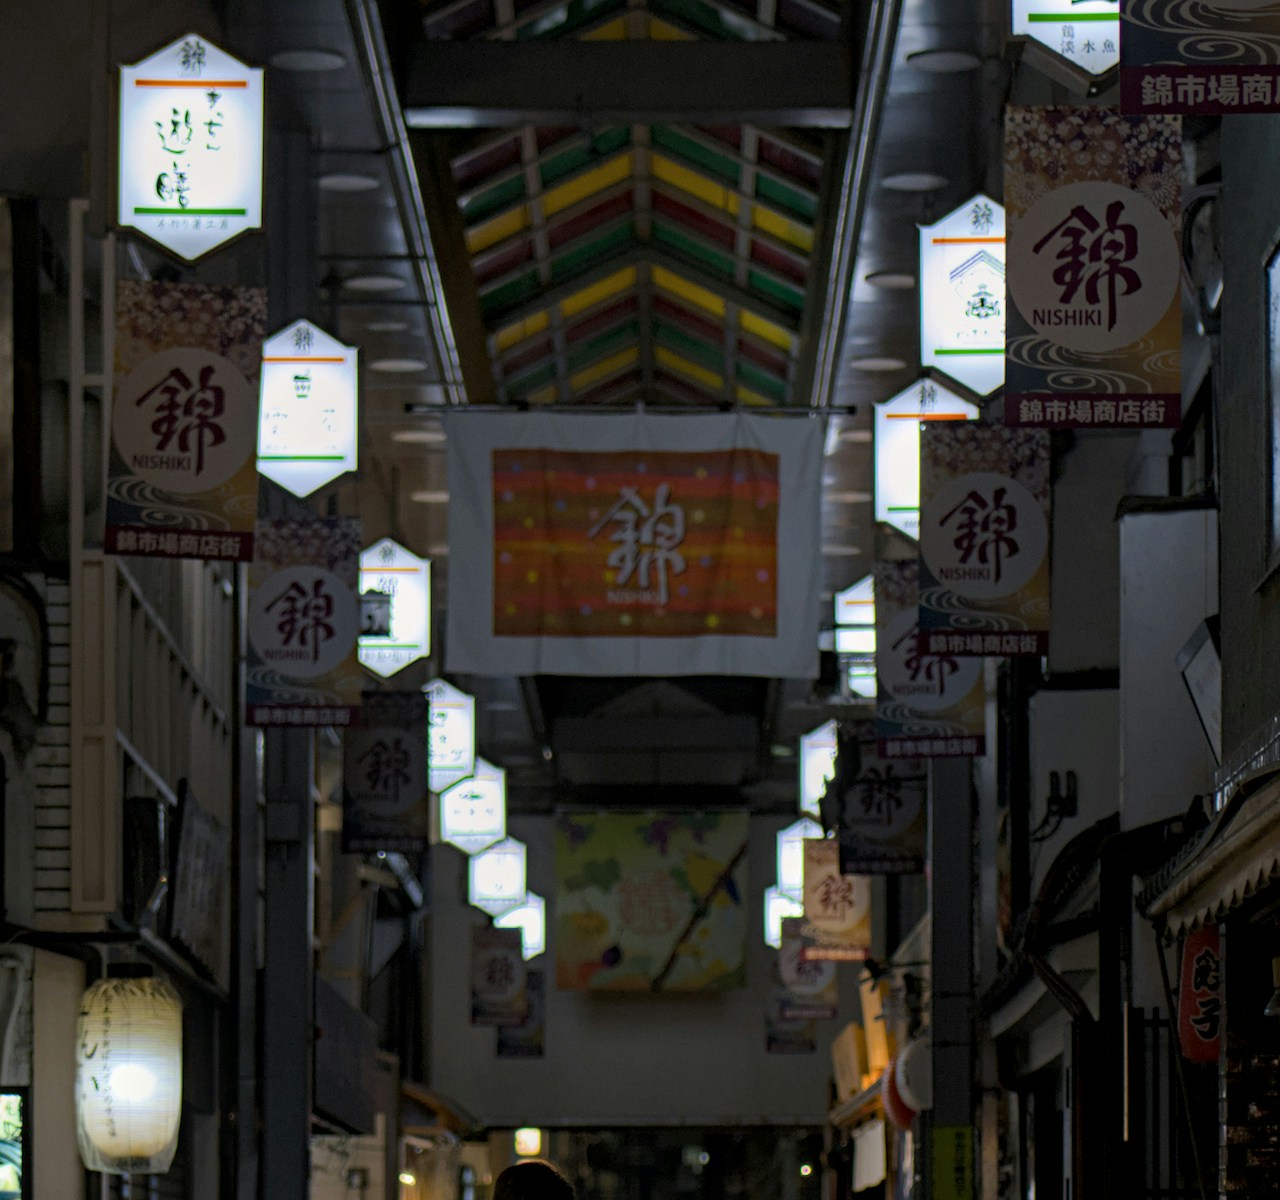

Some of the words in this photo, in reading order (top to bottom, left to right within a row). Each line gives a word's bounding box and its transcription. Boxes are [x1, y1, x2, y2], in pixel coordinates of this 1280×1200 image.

[1032, 200, 1143, 333] 錦
[1032, 307, 1102, 327] NISHIKI
[135, 364, 227, 477] 錦
[1018, 399, 1166, 425] 錦市場商店街
[131, 452, 192, 473] NISHIKI
[115, 530, 241, 559] 錦市場商店街
[587, 481, 687, 607] 錦
[940, 487, 1020, 584] 錦
[938, 567, 991, 581] NISHIKI
[265, 579, 335, 664] 錦
[928, 633, 1038, 655] 錦市場商店街
